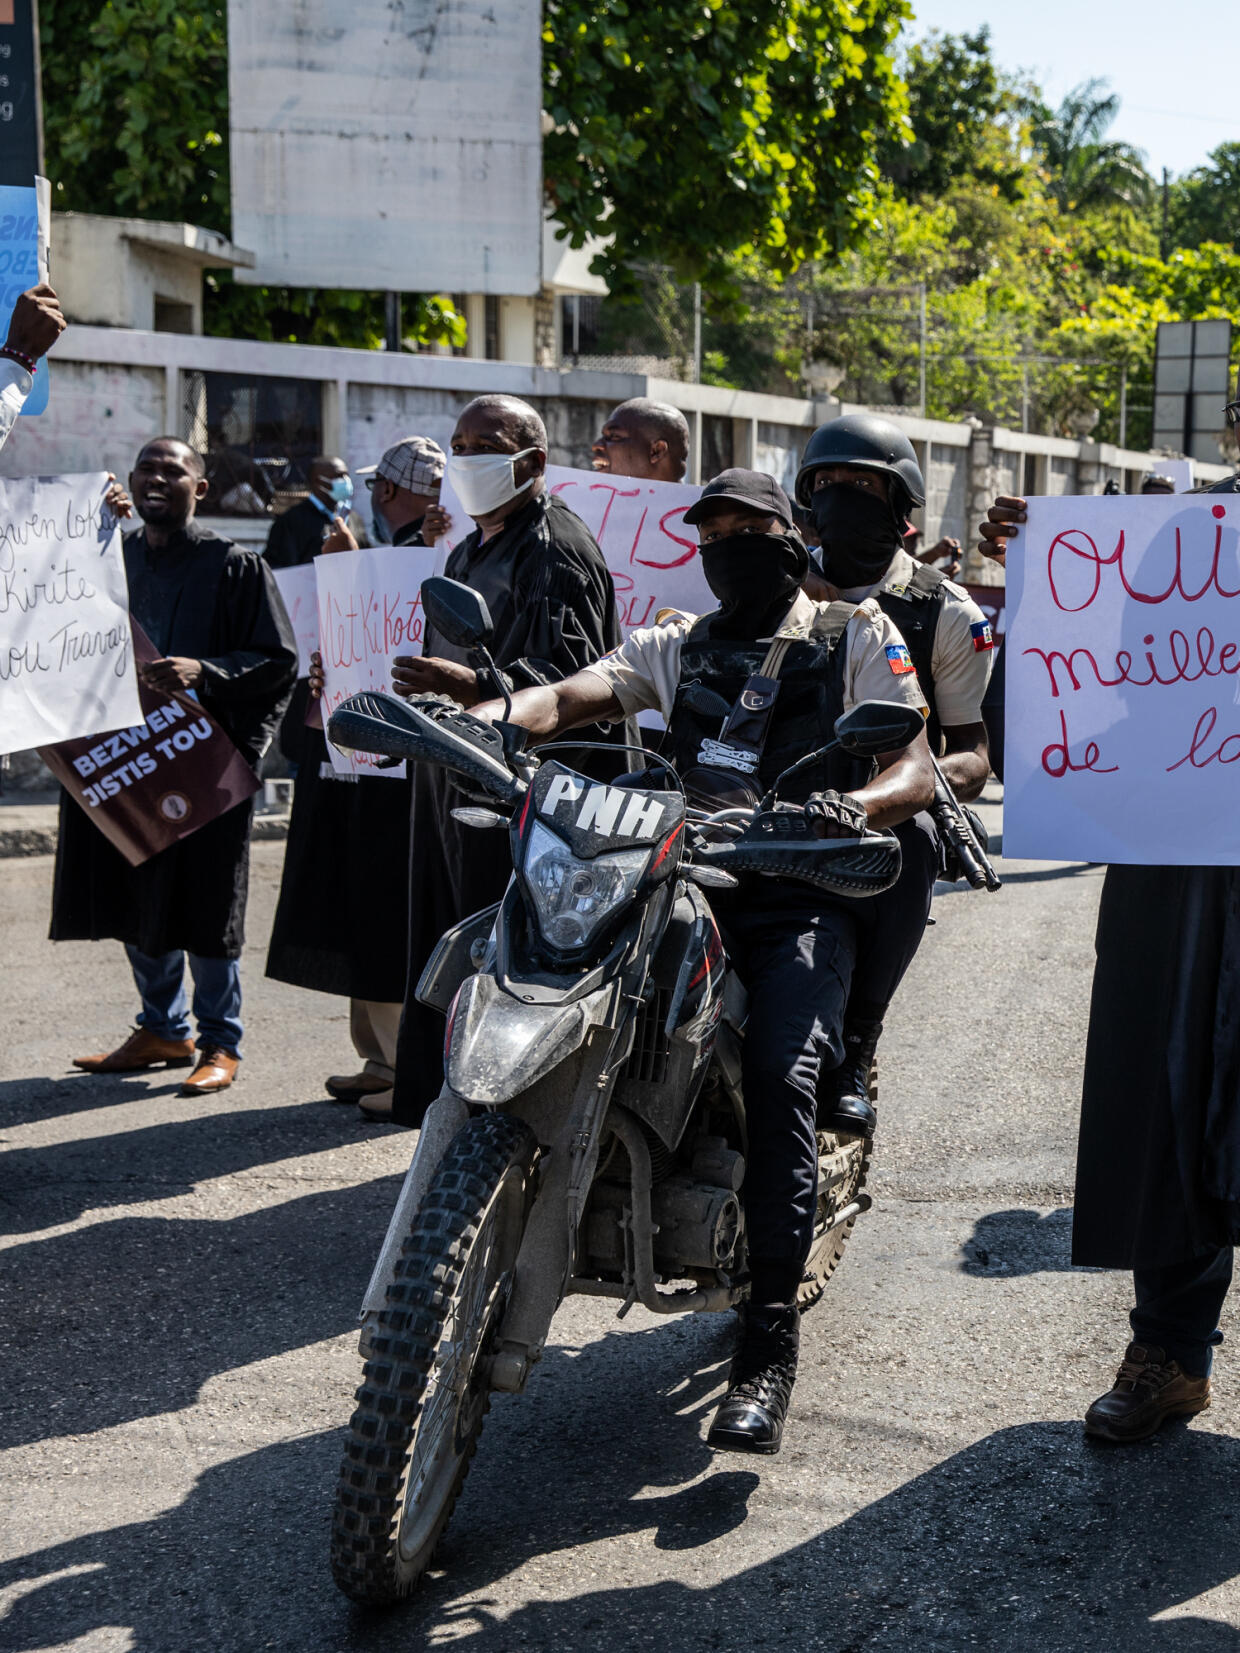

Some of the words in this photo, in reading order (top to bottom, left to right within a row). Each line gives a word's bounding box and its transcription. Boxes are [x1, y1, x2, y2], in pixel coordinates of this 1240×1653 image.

[72, 699, 187, 778] BEZWEN
[81, 751, 158, 808] JISTIS
[154, 716, 213, 761] TOU
[1041, 709, 1120, 778] de
[541, 774, 665, 839] PNH
